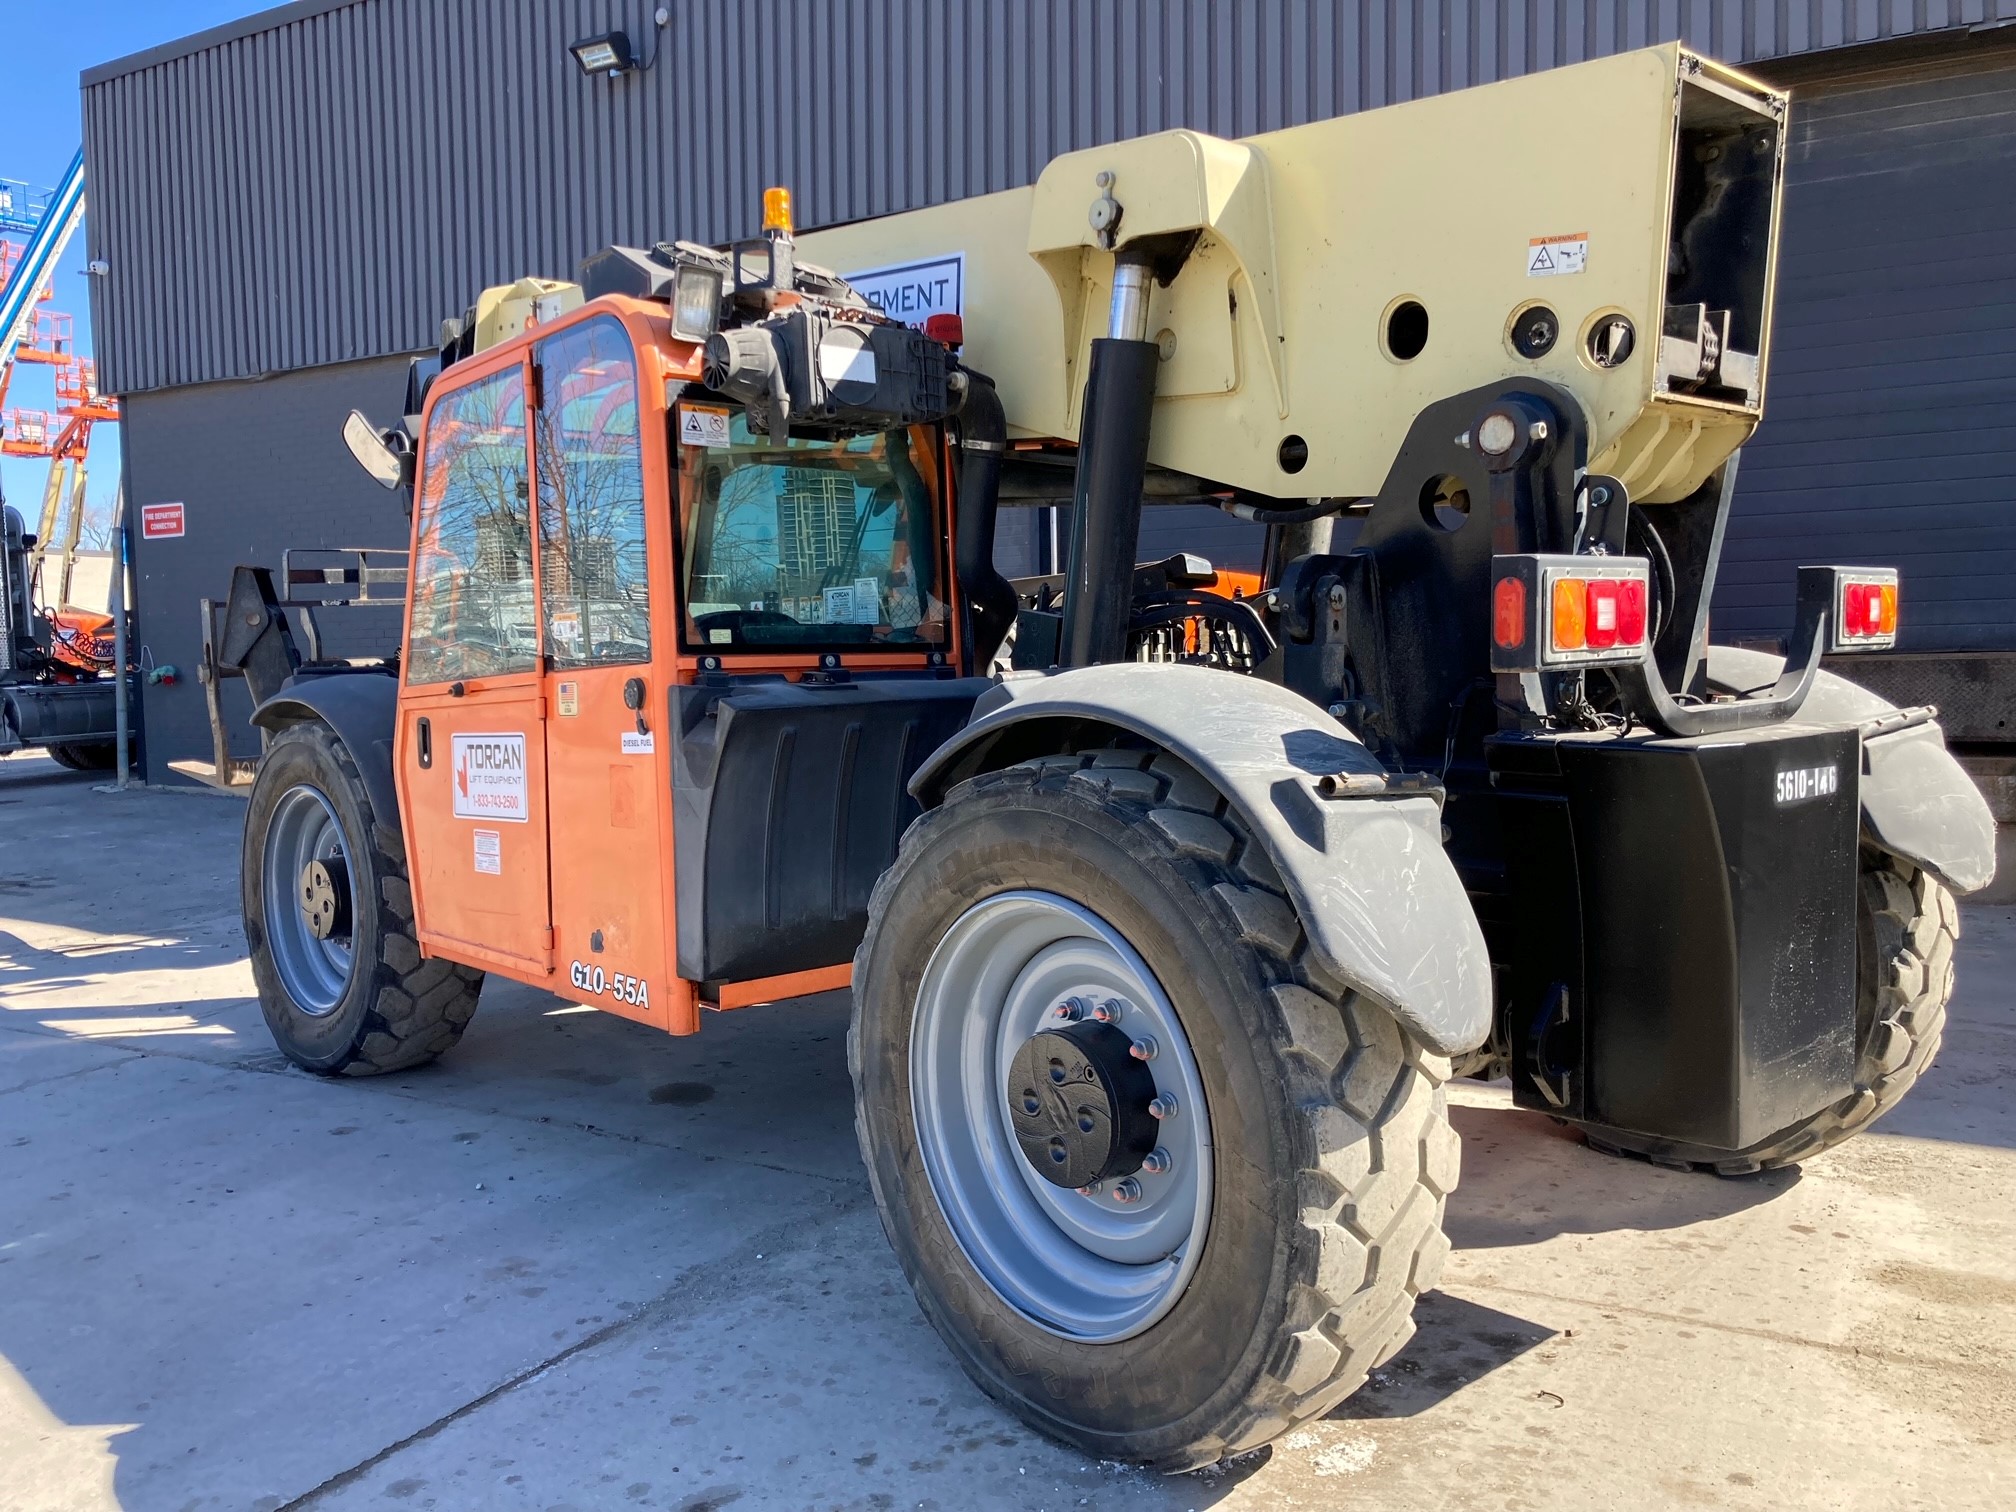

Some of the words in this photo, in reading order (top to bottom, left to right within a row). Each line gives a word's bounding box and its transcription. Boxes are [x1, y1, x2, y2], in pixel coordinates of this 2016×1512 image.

[1547, 234, 1577, 243] WARNING
[155, 511, 181, 520] DEPARTMENT
[150, 522, 177, 530] CONNECTION
[623, 739, 640, 748] DIESEL
[640, 738, 652, 747] FUEL
[467, 744, 521, 770] TORCAN
[469, 775, 482, 784] LIFT
[484, 775, 522, 785] EQUIPMENT
[1777, 766, 1837, 802] 5610-146
[473, 794, 519, 809] 1-833-743-2500
[570, 960, 650, 1010] G10-55A
